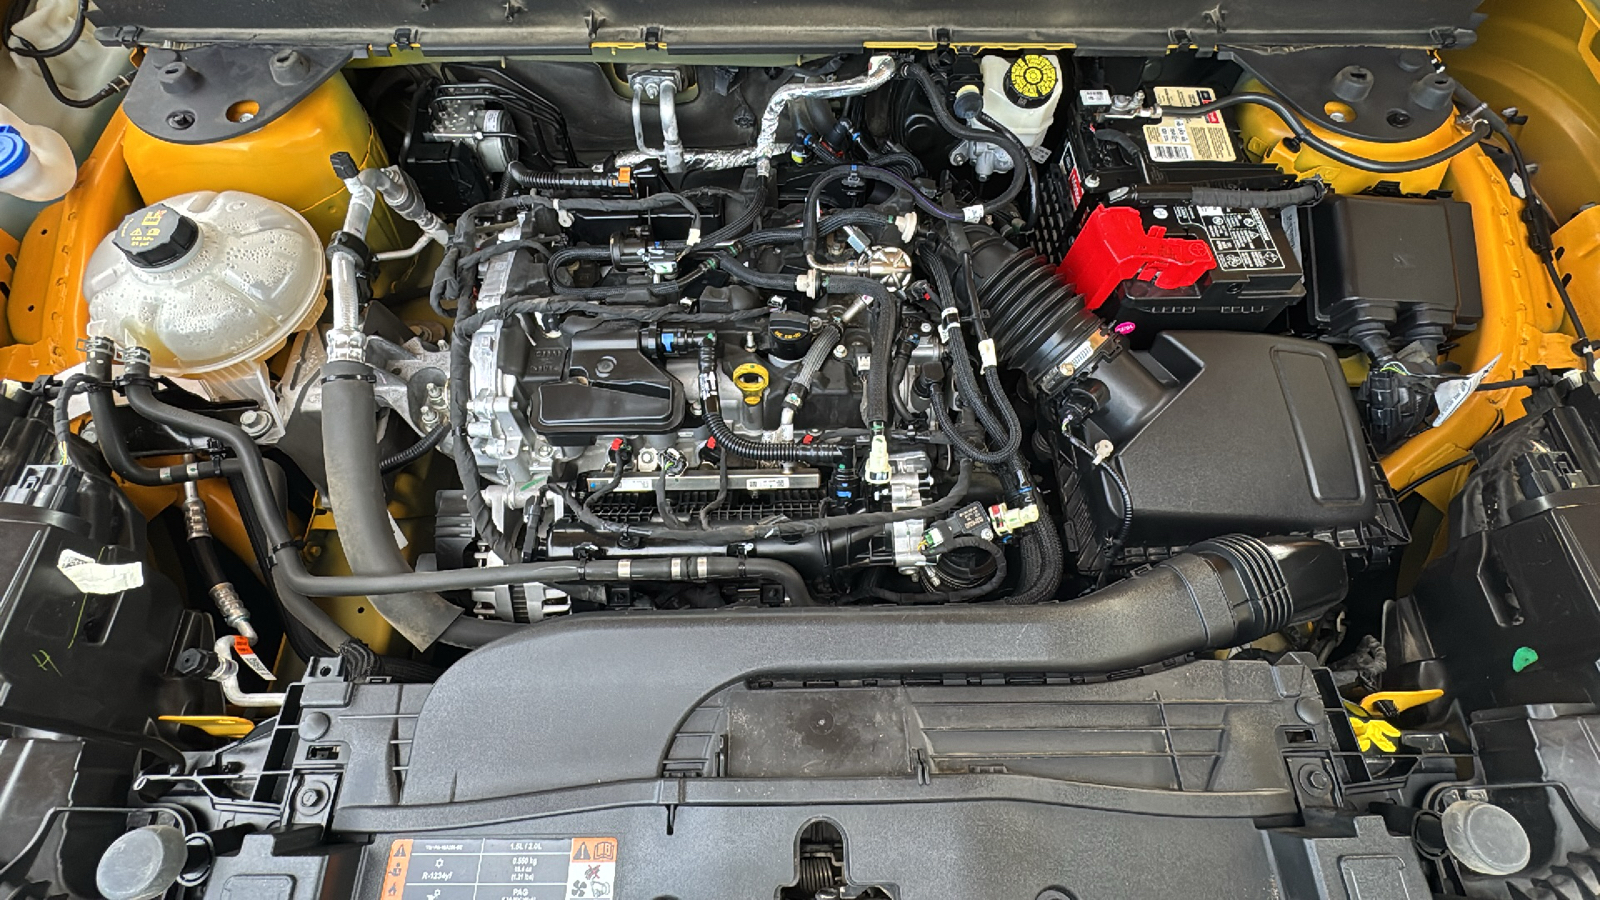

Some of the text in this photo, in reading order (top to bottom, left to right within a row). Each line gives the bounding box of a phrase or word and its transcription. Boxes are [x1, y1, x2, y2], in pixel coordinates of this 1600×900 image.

[528, 842, 542, 850] 2.0L
[529, 856, 537, 866] kg
[421, 871, 453, 881] R-1234yf
[512, 887, 529, 896] PAG
